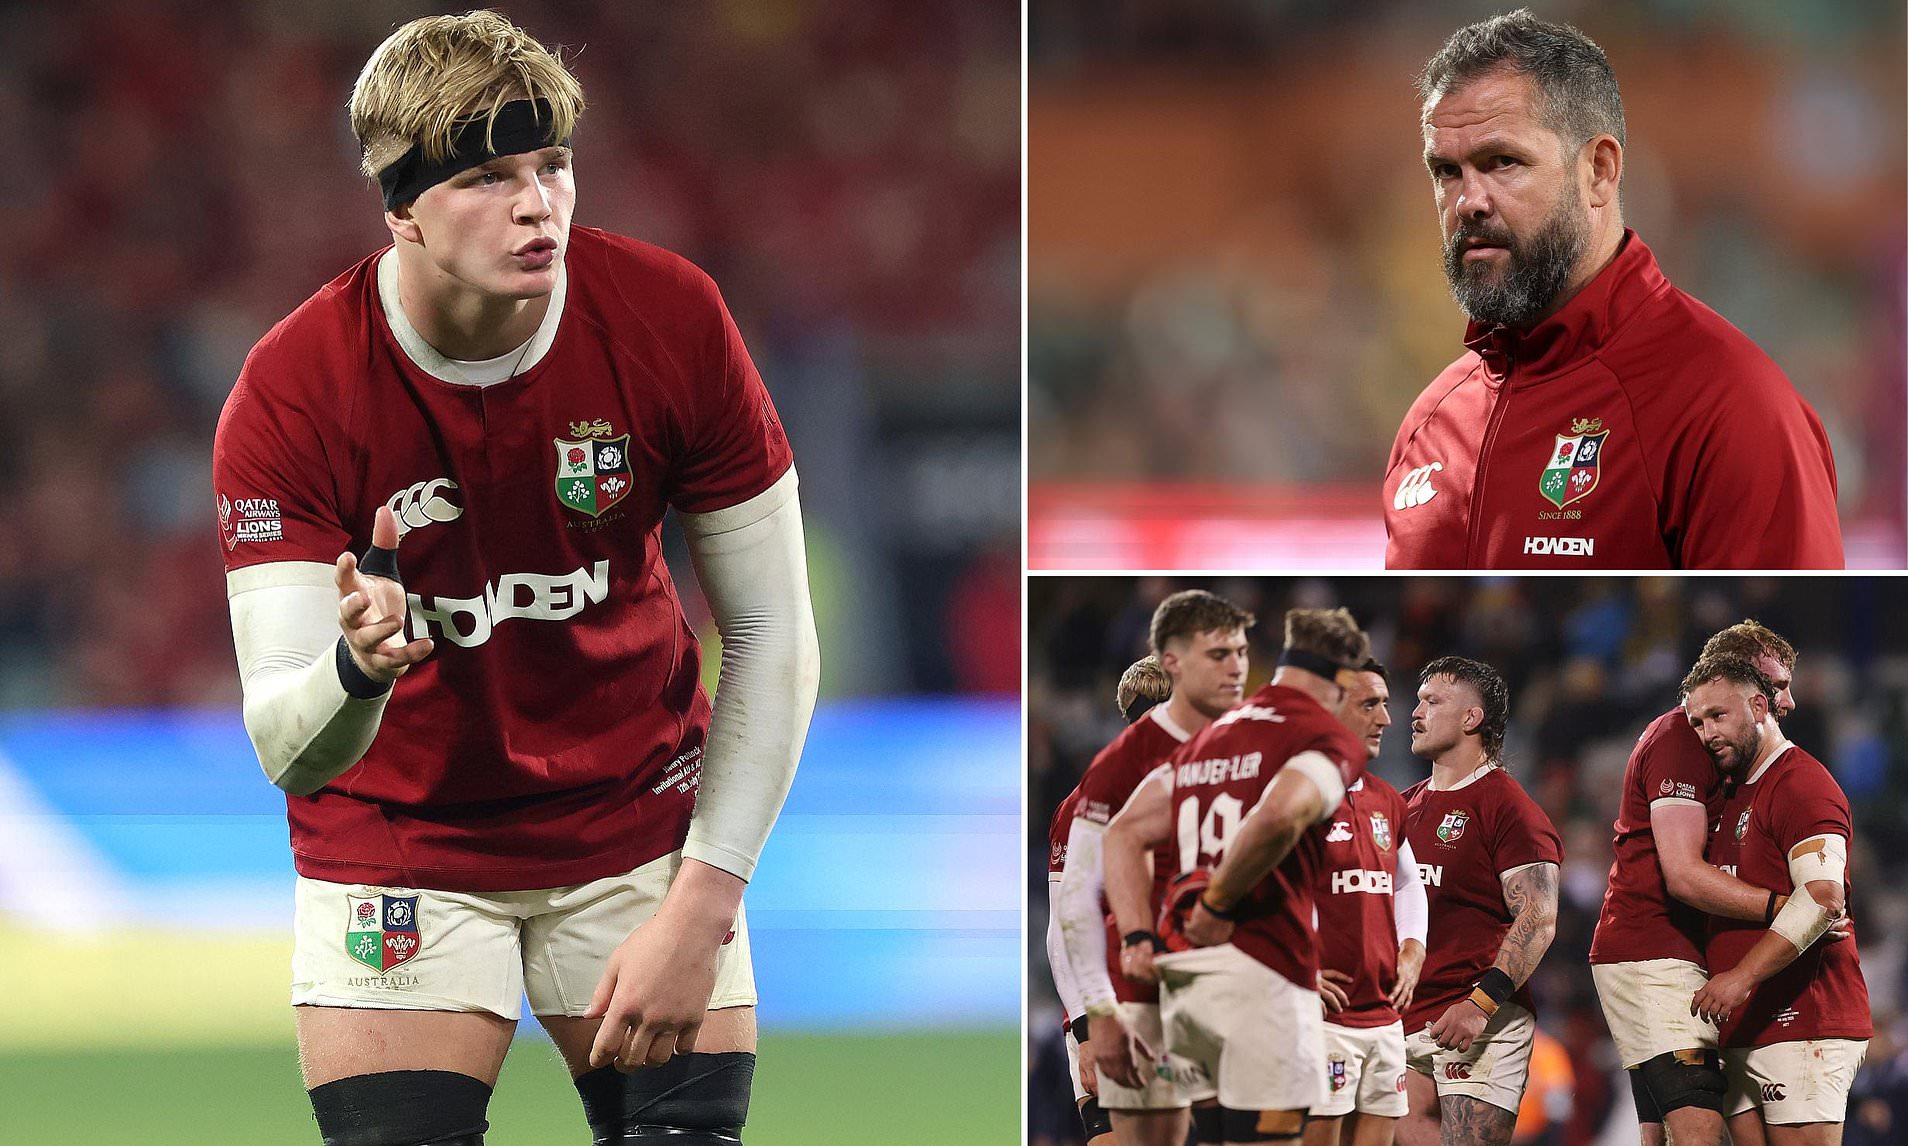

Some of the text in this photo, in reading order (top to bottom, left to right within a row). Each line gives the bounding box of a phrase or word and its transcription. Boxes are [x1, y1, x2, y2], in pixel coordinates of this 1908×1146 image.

[235, 499, 279, 513] QATAR
[245, 510, 281, 518] AIRWAYS
[1538, 510, 1582, 520] SINCE 1888
[237, 520, 282, 533] LIONS
[1524, 536, 1594, 556] HOWDEN
[407, 559, 609, 647] HOWDEN
[663, 758, 682, 774] Henry
[652, 769, 685, 795] Invitational
[1177, 792, 1244, 876] 19
[347, 975, 420, 987] AUSTRALIA
